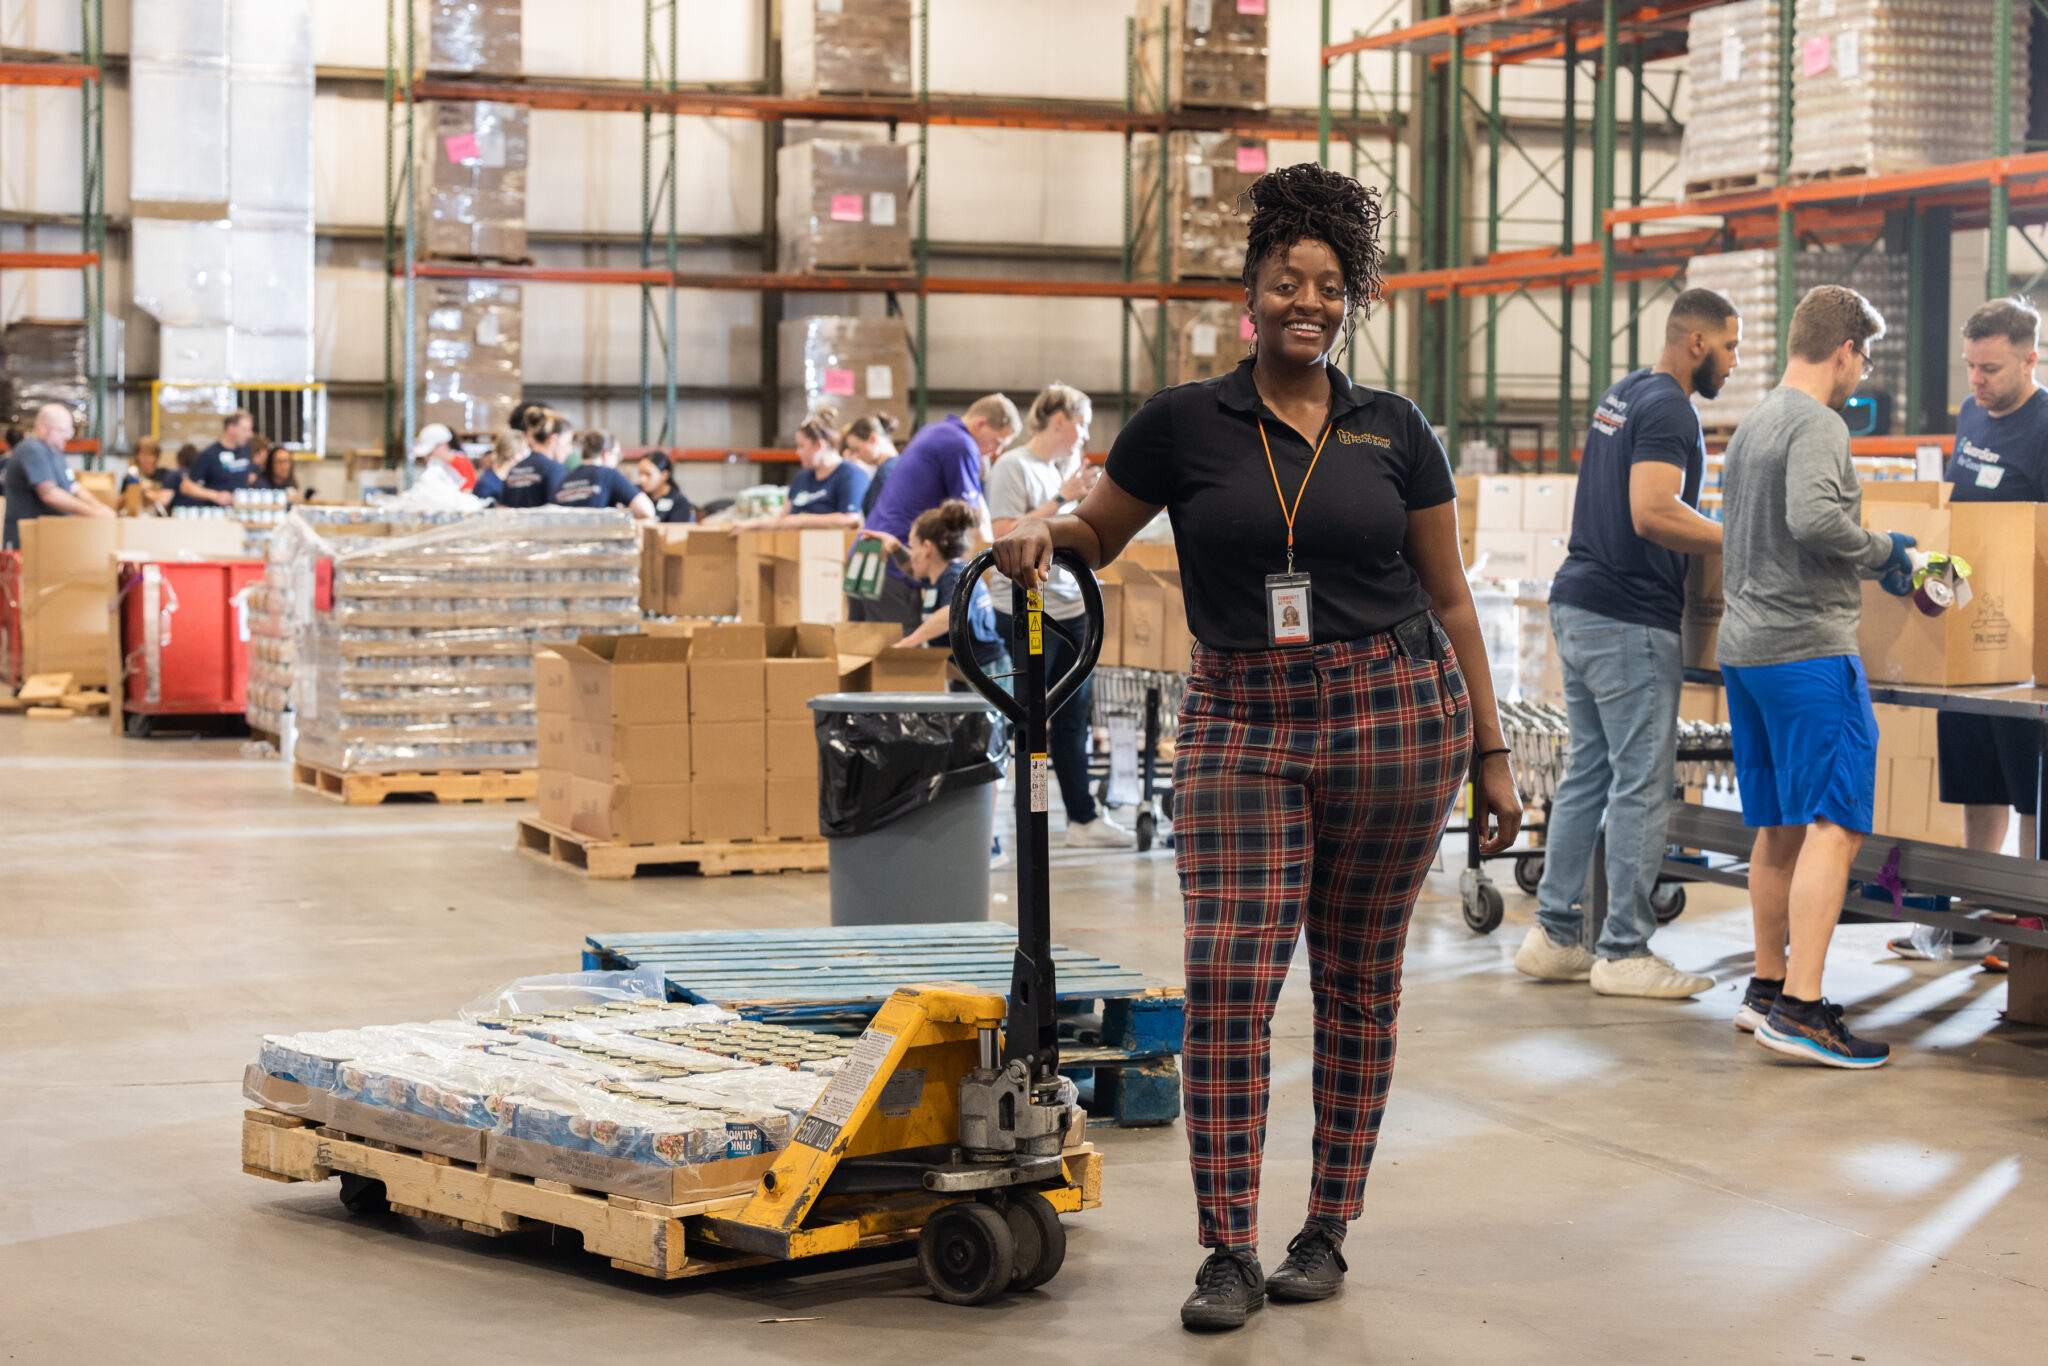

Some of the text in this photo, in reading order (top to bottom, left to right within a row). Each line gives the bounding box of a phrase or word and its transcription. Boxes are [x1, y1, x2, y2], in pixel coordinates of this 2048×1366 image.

[1373, 440, 1391, 449] BANK
[1963, 441, 2000, 464] Guardian
[797, 1119, 839, 1150] 5500 LBS
[731, 1140, 751, 1151] PINK
